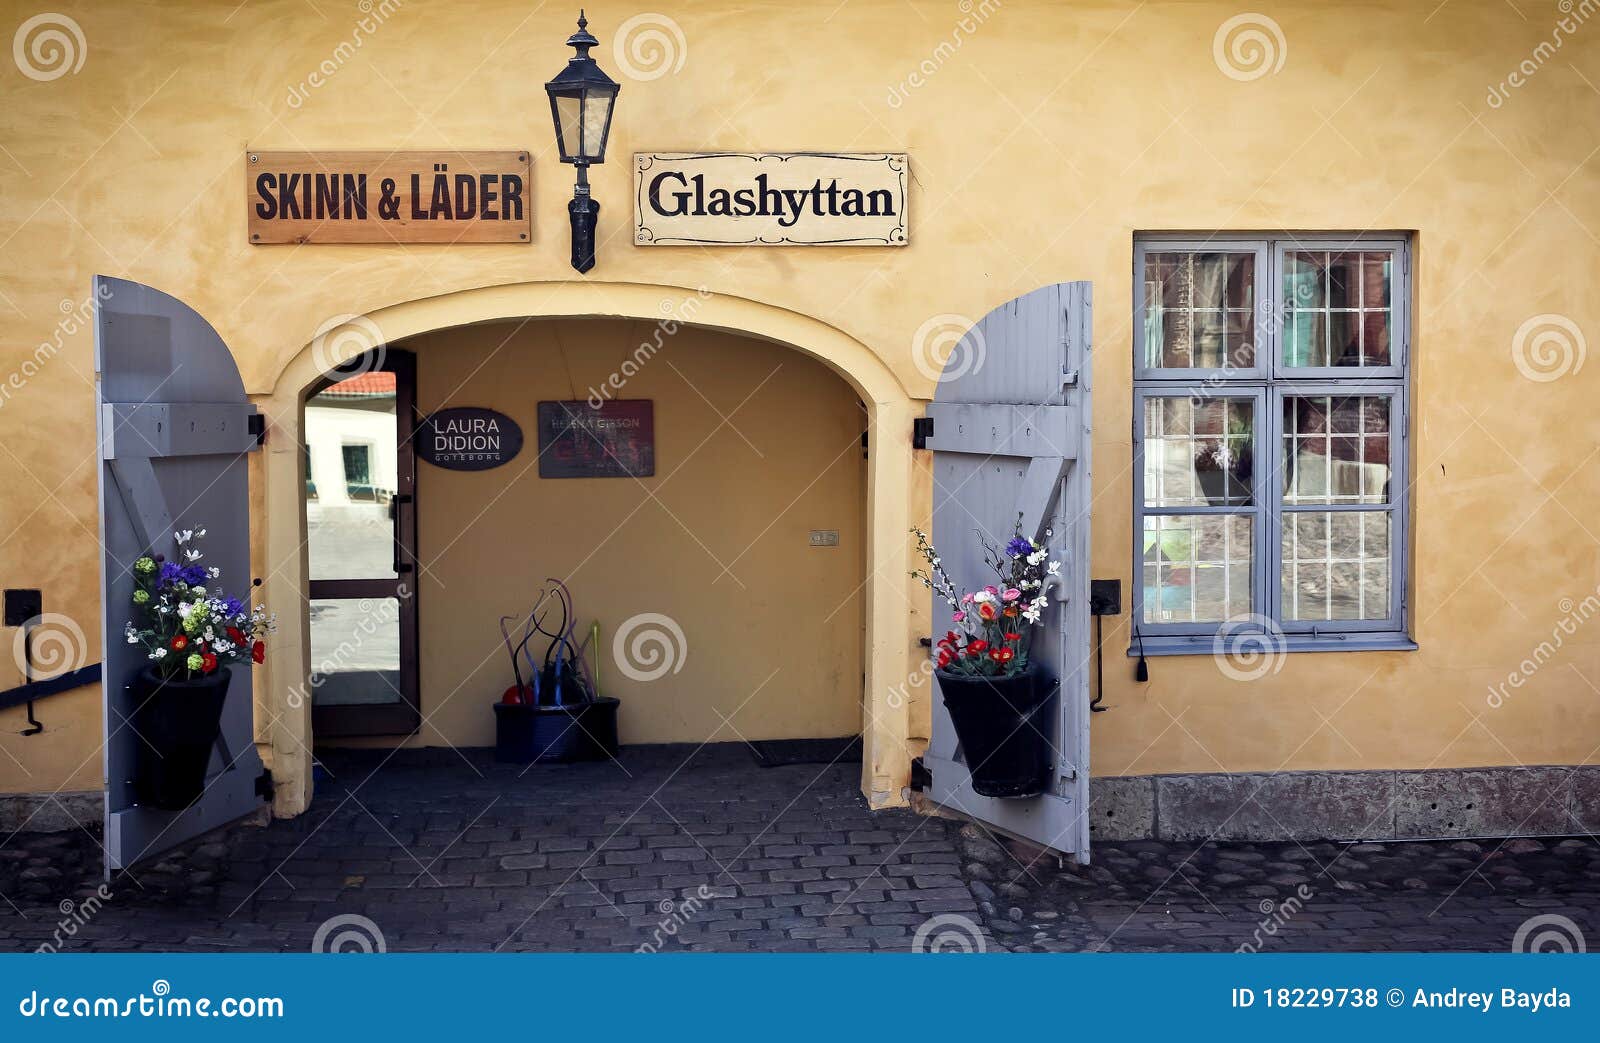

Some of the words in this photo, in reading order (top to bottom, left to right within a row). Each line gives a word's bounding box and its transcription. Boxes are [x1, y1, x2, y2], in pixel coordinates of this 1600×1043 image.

[256, 173, 367, 220] SKINN
[378, 177, 401, 220] &
[411, 163, 524, 220] LÄDER
[648, 171, 897, 228] Glashyttan
[434, 418, 500, 434] LAURA
[434, 435, 500, 451] DIDION
